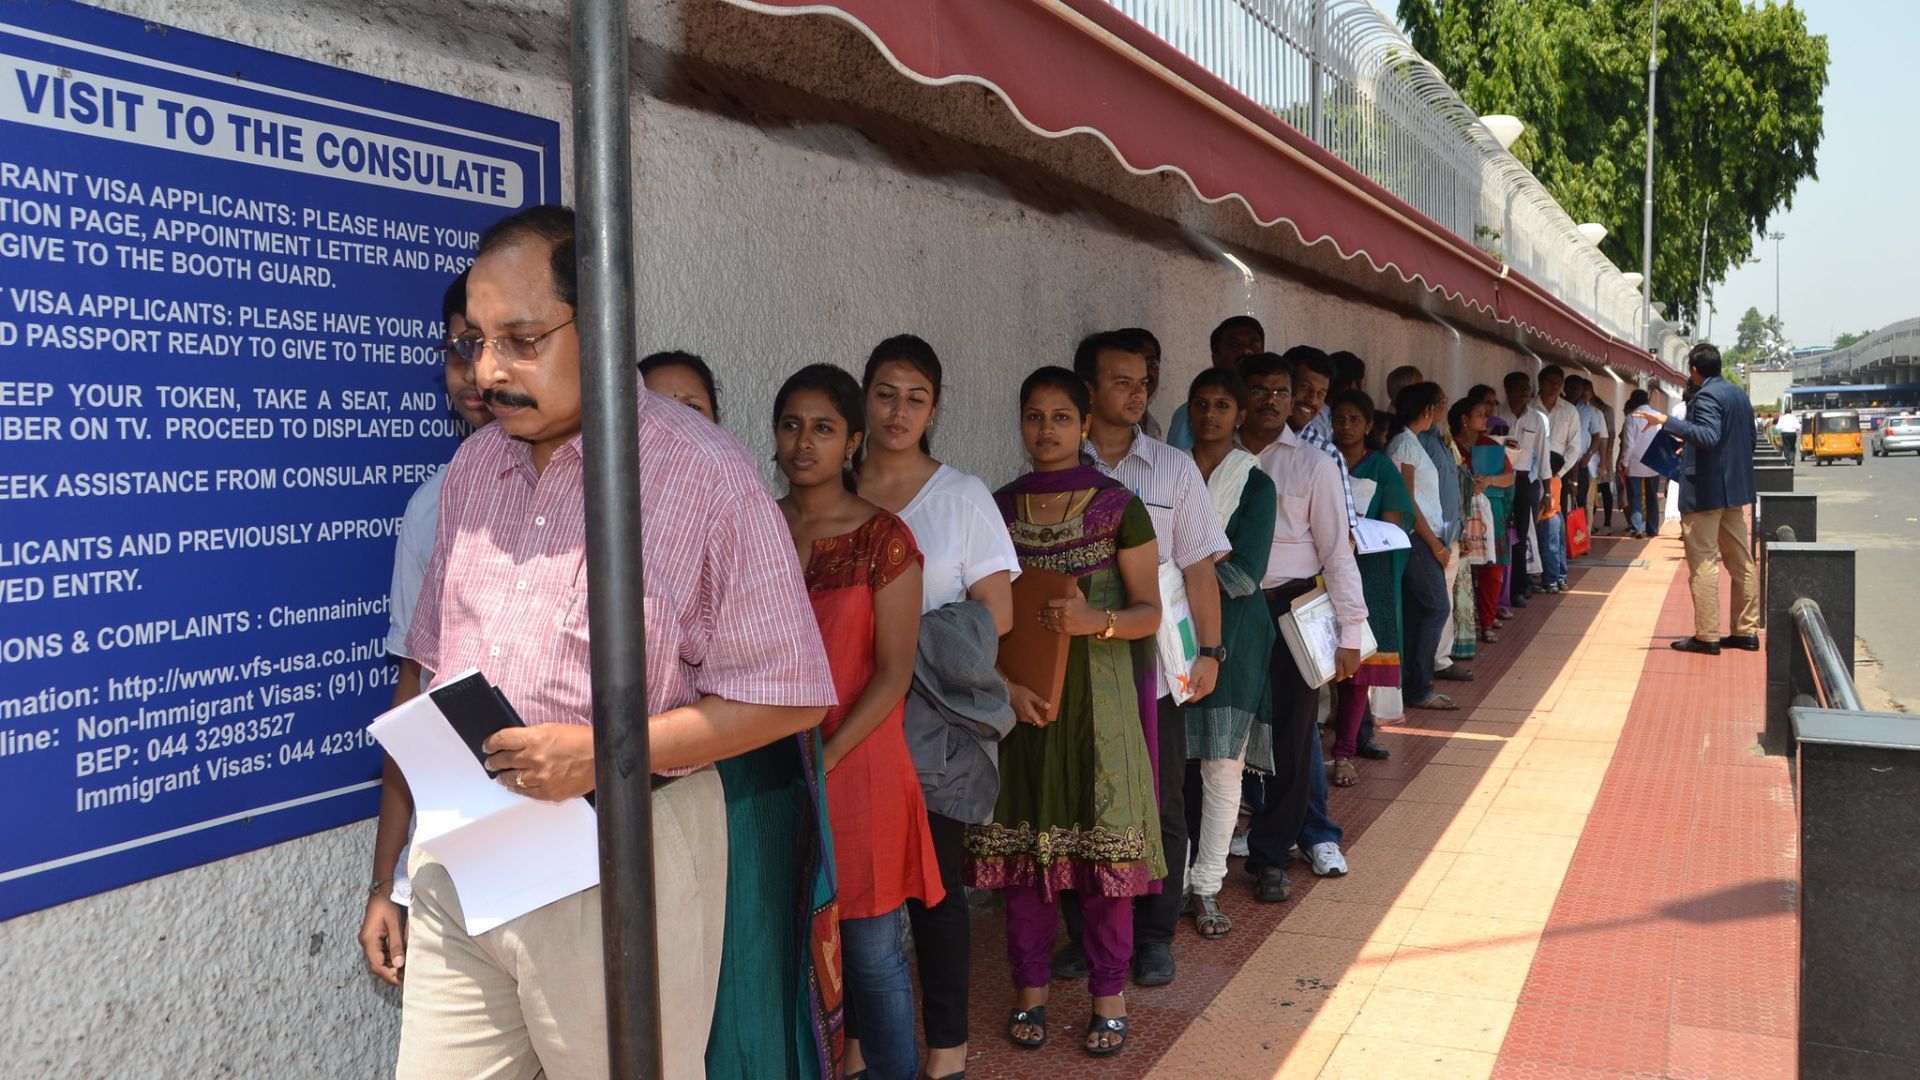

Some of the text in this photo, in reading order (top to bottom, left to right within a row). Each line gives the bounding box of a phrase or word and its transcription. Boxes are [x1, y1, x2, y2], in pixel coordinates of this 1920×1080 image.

[15, 69, 506, 198] VISIT TO THE CONSULATE
[1, 162, 481, 250] RANT VISA APPLICANTS: PLEASE HAVE YOUR
[0, 232, 336, 289] GIVE TO THE BOOTH GUARD.
[71, 206, 147, 242] PAGE,
[153, 217, 311, 257] APPOINTMENT
[318, 238, 389, 266] LETTER
[393, 248, 430, 270] AND
[10, 287, 74, 316] VISA
[78, 293, 233, 326] APPLICANTS:
[240, 305, 318, 332] PLEASE
[324, 312, 371, 335] HAVE
[376, 316, 424, 338] YOUR
[27, 323, 162, 353] PASSPORT
[169, 331, 244, 357] READY
[249, 336, 276, 358] TO
[282, 338, 327, 361] GIVE
[332, 341, 357, 362] TO
[361, 342, 396, 364] THE
[0, 381, 54, 407] EEP
[69, 383, 143, 408] YOUR
[156, 385, 241, 413] TOKEN,
[253, 388, 308, 410] TAKE
[318, 389, 332, 410] A
[342, 390, 391, 414] SEAT,
[401, 391, 437, 411] AND
[0, 416, 63, 441] BER
[70, 416, 108, 441] ON
[116, 417, 152, 440] TV.
[166, 417, 274, 440] PROCEED
[280, 418, 307, 439] TO
[314, 418, 414, 439] DISPLAYED
[55, 470, 209, 498] ASSISTANCE
[216, 468, 277, 491] FROM
[283, 465, 388, 489] CONSULAR
[119, 532, 172, 558] AND
[179, 522, 313, 553] PREVIOUSLY
[0, 568, 143, 604] ED ENTRY.
[0, 633, 64, 664] ONS
[71, 630, 90, 654] &
[97, 610, 250, 651] COMPLAINTS
[0, 728, 60, 757] line:
[78, 689, 254, 742] Non-Immigrant
[260, 682, 322, 708] Visas:
[329, 670, 364, 701] (91)
[77, 712, 295, 778] BEP: 044 32983527
[77, 763, 201, 813] Immigrant
[207, 752, 272, 781] Visas:
[280, 738, 315, 766] 044
